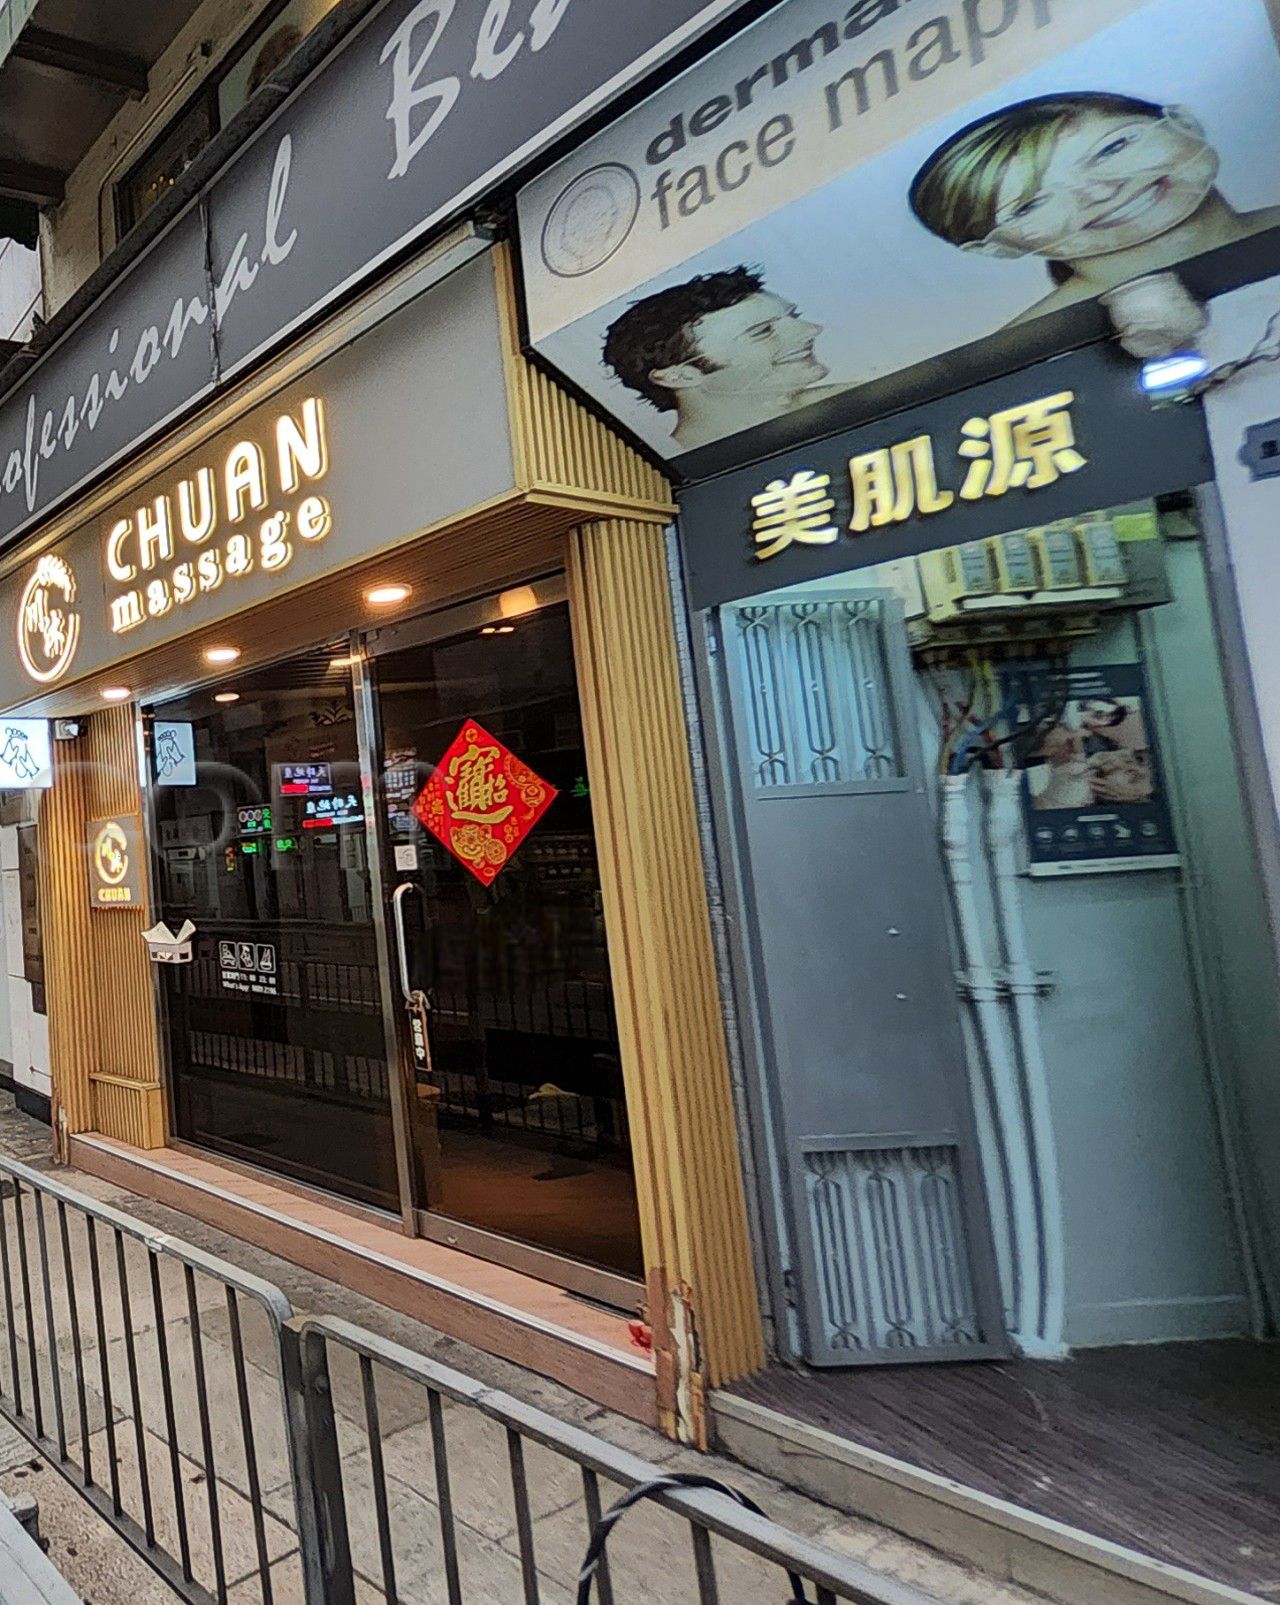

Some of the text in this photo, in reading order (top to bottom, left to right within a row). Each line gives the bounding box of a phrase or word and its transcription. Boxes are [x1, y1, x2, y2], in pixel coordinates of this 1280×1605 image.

[645, 0, 912, 165] derma
[651, 0, 1053, 231] face map
[106, 397, 329, 582] CHUAN
[751, 390, 1088, 562] 美肌源
[111, 495, 333, 634] massage
[97, 886, 132, 902] CHUAN
